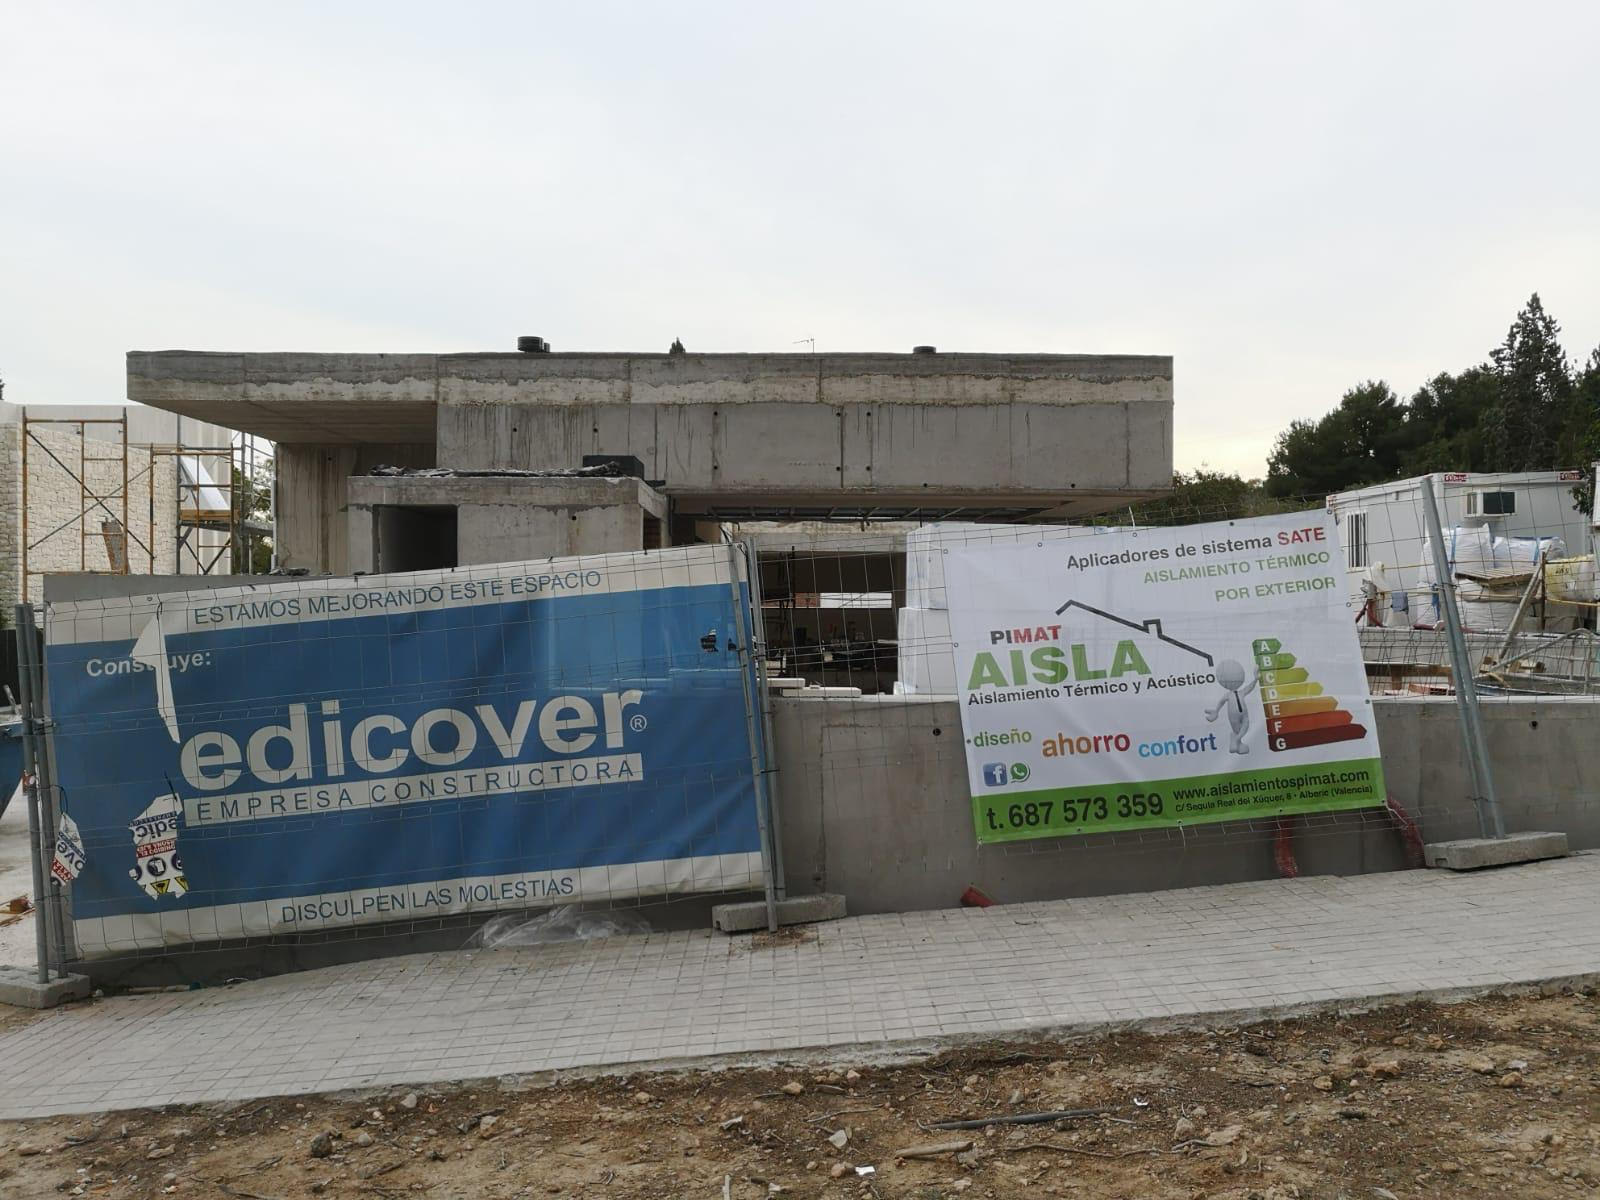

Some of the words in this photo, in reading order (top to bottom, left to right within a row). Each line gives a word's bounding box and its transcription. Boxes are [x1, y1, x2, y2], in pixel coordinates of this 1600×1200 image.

[1067, 547, 1169, 571] Aplicadores
[1175, 543, 1196, 557] de
[1202, 536, 1272, 555] sistema
[1277, 527, 1326, 546] SATE
[1143, 561, 1250, 584] AISLAMIENTO
[1256, 551, 1330, 571] TÉRMICO
[195, 600, 301, 625] ESTAMOS
[308, 586, 443, 615] MEJORANDO
[450, 580, 504, 601] ESTE
[511, 570, 601, 595] ESPACIO
[1215, 587, 1249, 602] POR
[1256, 577, 1336, 597] EXTERIOR
[990, 625, 1062, 645] PIMAT
[1260, 640, 1270, 651] A
[86, 652, 211, 677] Consuye:
[967, 639, 1152, 690] AISLA
[1263, 656, 1272, 667] B
[968, 686, 1060, 706] Aislamiento
[1064, 680, 1128, 698] Térmico
[1132, 682, 1141, 694] y
[1146, 672, 1216, 690] Acústico
[1265, 672, 1275, 683] C
[1267, 688, 1278, 699] D
[1271, 704, 1280, 716] E
[180, 689, 643, 791] edicover
[973, 727, 1032, 748] diseño
[1042, 731, 1131, 758] ahorro
[1138, 732, 1217, 758] confort
[1274, 721, 1283, 733] F
[1276, 738, 1287, 750] G
[197, 788, 354, 821] EMPRESA
[371, 760, 634, 803] CONSTRUCTORA
[1173, 769, 1369, 800] www.aislamientospimat.com
[1063, 796, 1108, 823] 573
[1118, 792, 1163, 818] 359
[281, 894, 406, 924] DISCULPEN
[412, 887, 453, 909] LAS
[458, 877, 574, 903] MOLESTIAS
